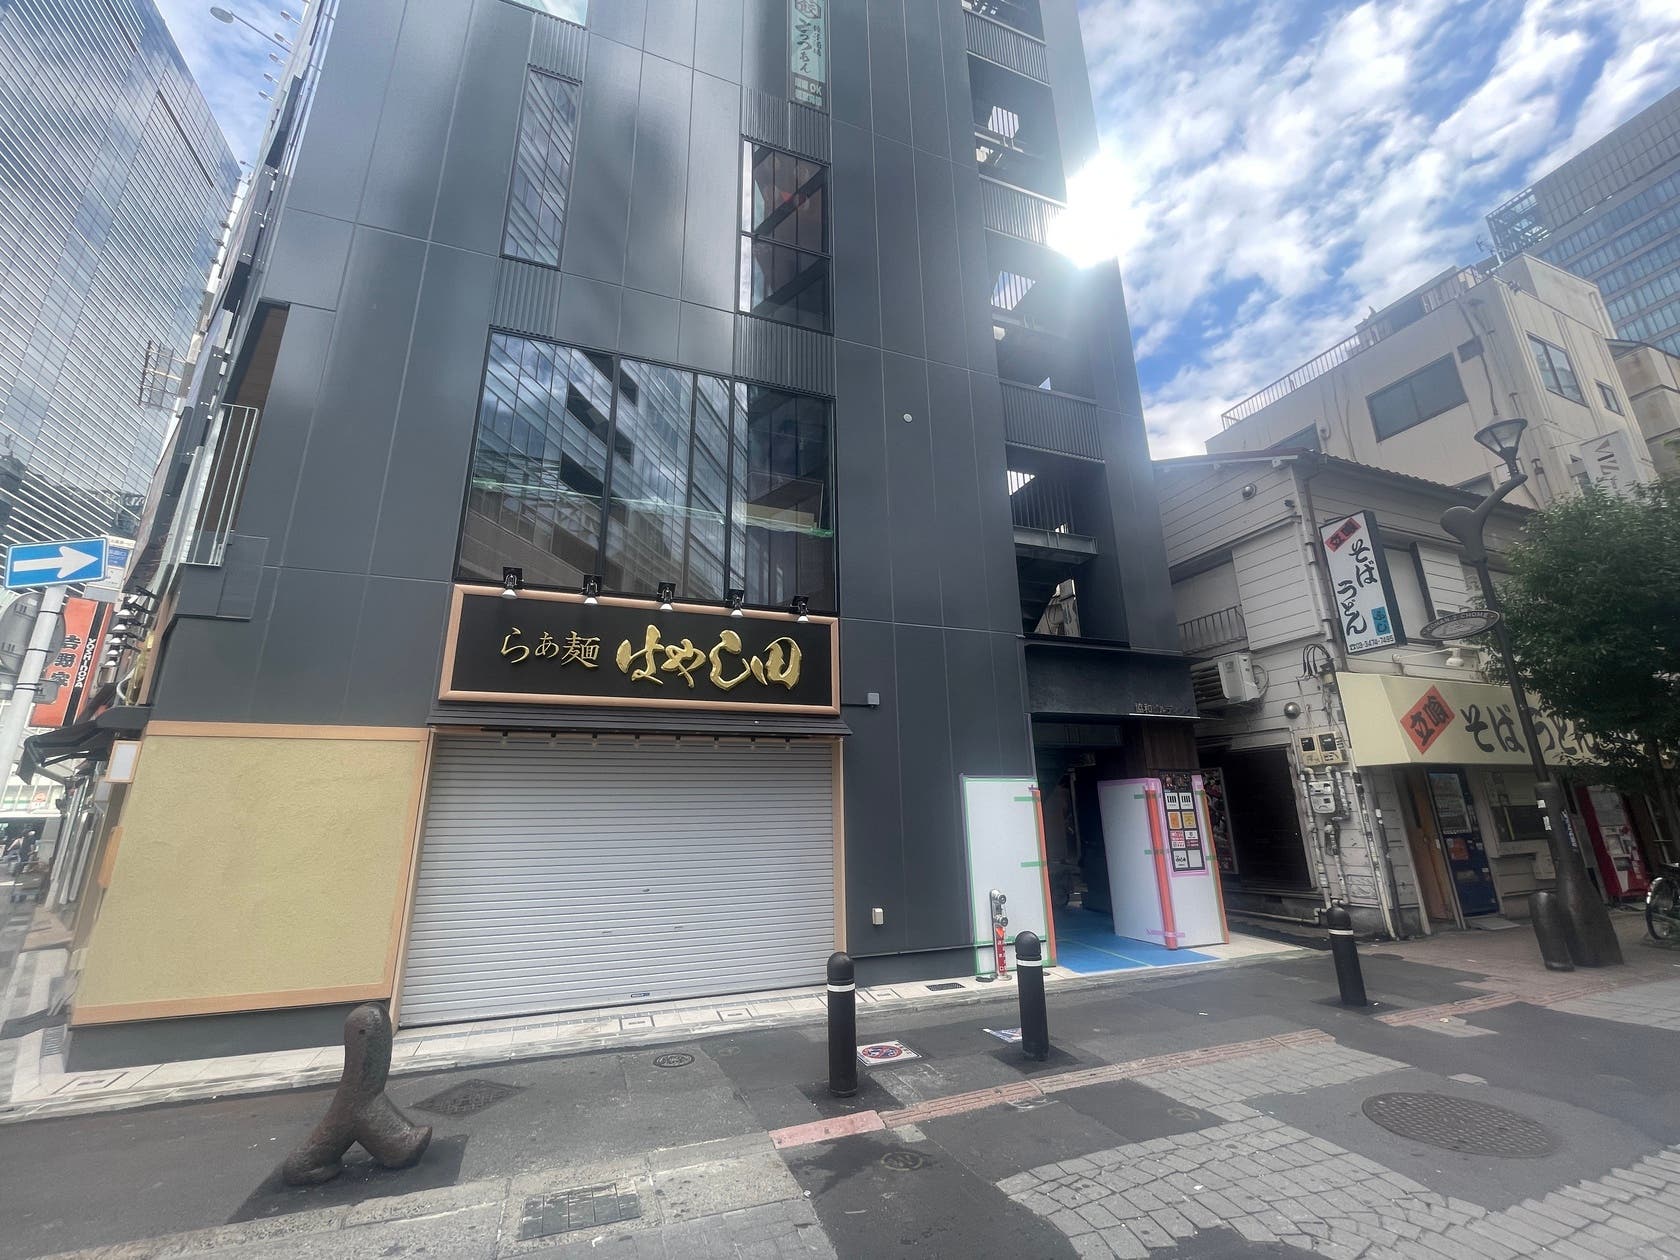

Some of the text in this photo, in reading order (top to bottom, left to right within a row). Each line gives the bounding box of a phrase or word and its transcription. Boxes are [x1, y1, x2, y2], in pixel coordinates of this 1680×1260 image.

[1348, 538, 1378, 588] そば
[1337, 578, 1368, 637] うどん
[74, 637, 97, 689] YOSHINOYA
[499, 624, 803, 691] らあ麺 はやし田
